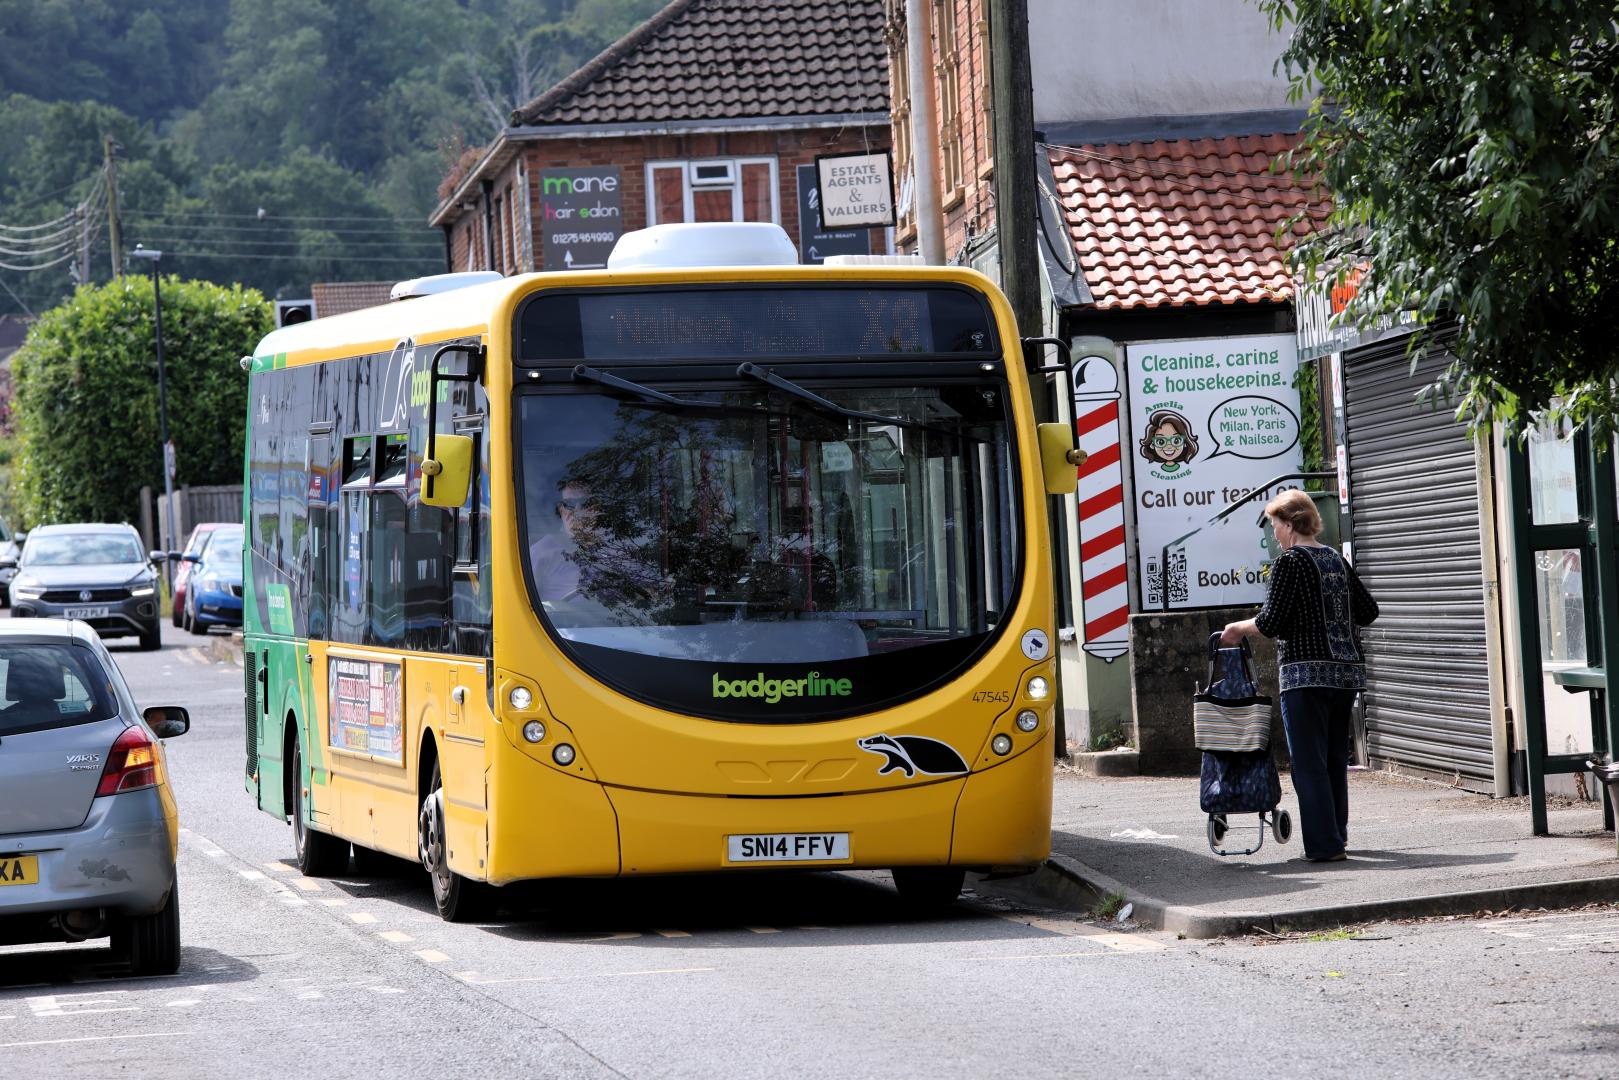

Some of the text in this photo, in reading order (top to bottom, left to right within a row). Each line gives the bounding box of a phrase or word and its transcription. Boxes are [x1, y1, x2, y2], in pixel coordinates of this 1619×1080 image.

[831, 164, 877, 177] ESTATE
[543, 176, 618, 195] mane
[828, 175, 882, 188] AGENTS
[849, 187, 864, 203] &
[544, 201, 576, 223] hair
[827, 203, 887, 217] VALUERS
[615, 307, 733, 345] Nailsea
[857, 297, 920, 352] X8
[1141, 352, 1221, 373] Cleaning,
[1226, 349, 1279, 368] caring
[1142, 371, 1287, 394] & housekeeping.
[1145, 400, 1184, 415] Amelia
[1223, 407, 1247, 418] New
[1257, 419, 1286, 430] Paris
[1224, 434, 1284, 447] & Nailsea.
[1150, 468, 1192, 481] Cleaning
[1141, 488, 1177, 509] Call
[1183, 490, 1216, 506] our
[1197, 569, 1241, 587] Book
[712, 670, 853, 704] badgerline
[972, 690, 1011, 703] 47545
[65, 753, 100, 764] YARIS
[741, 836, 835, 857] SN14 FFV
